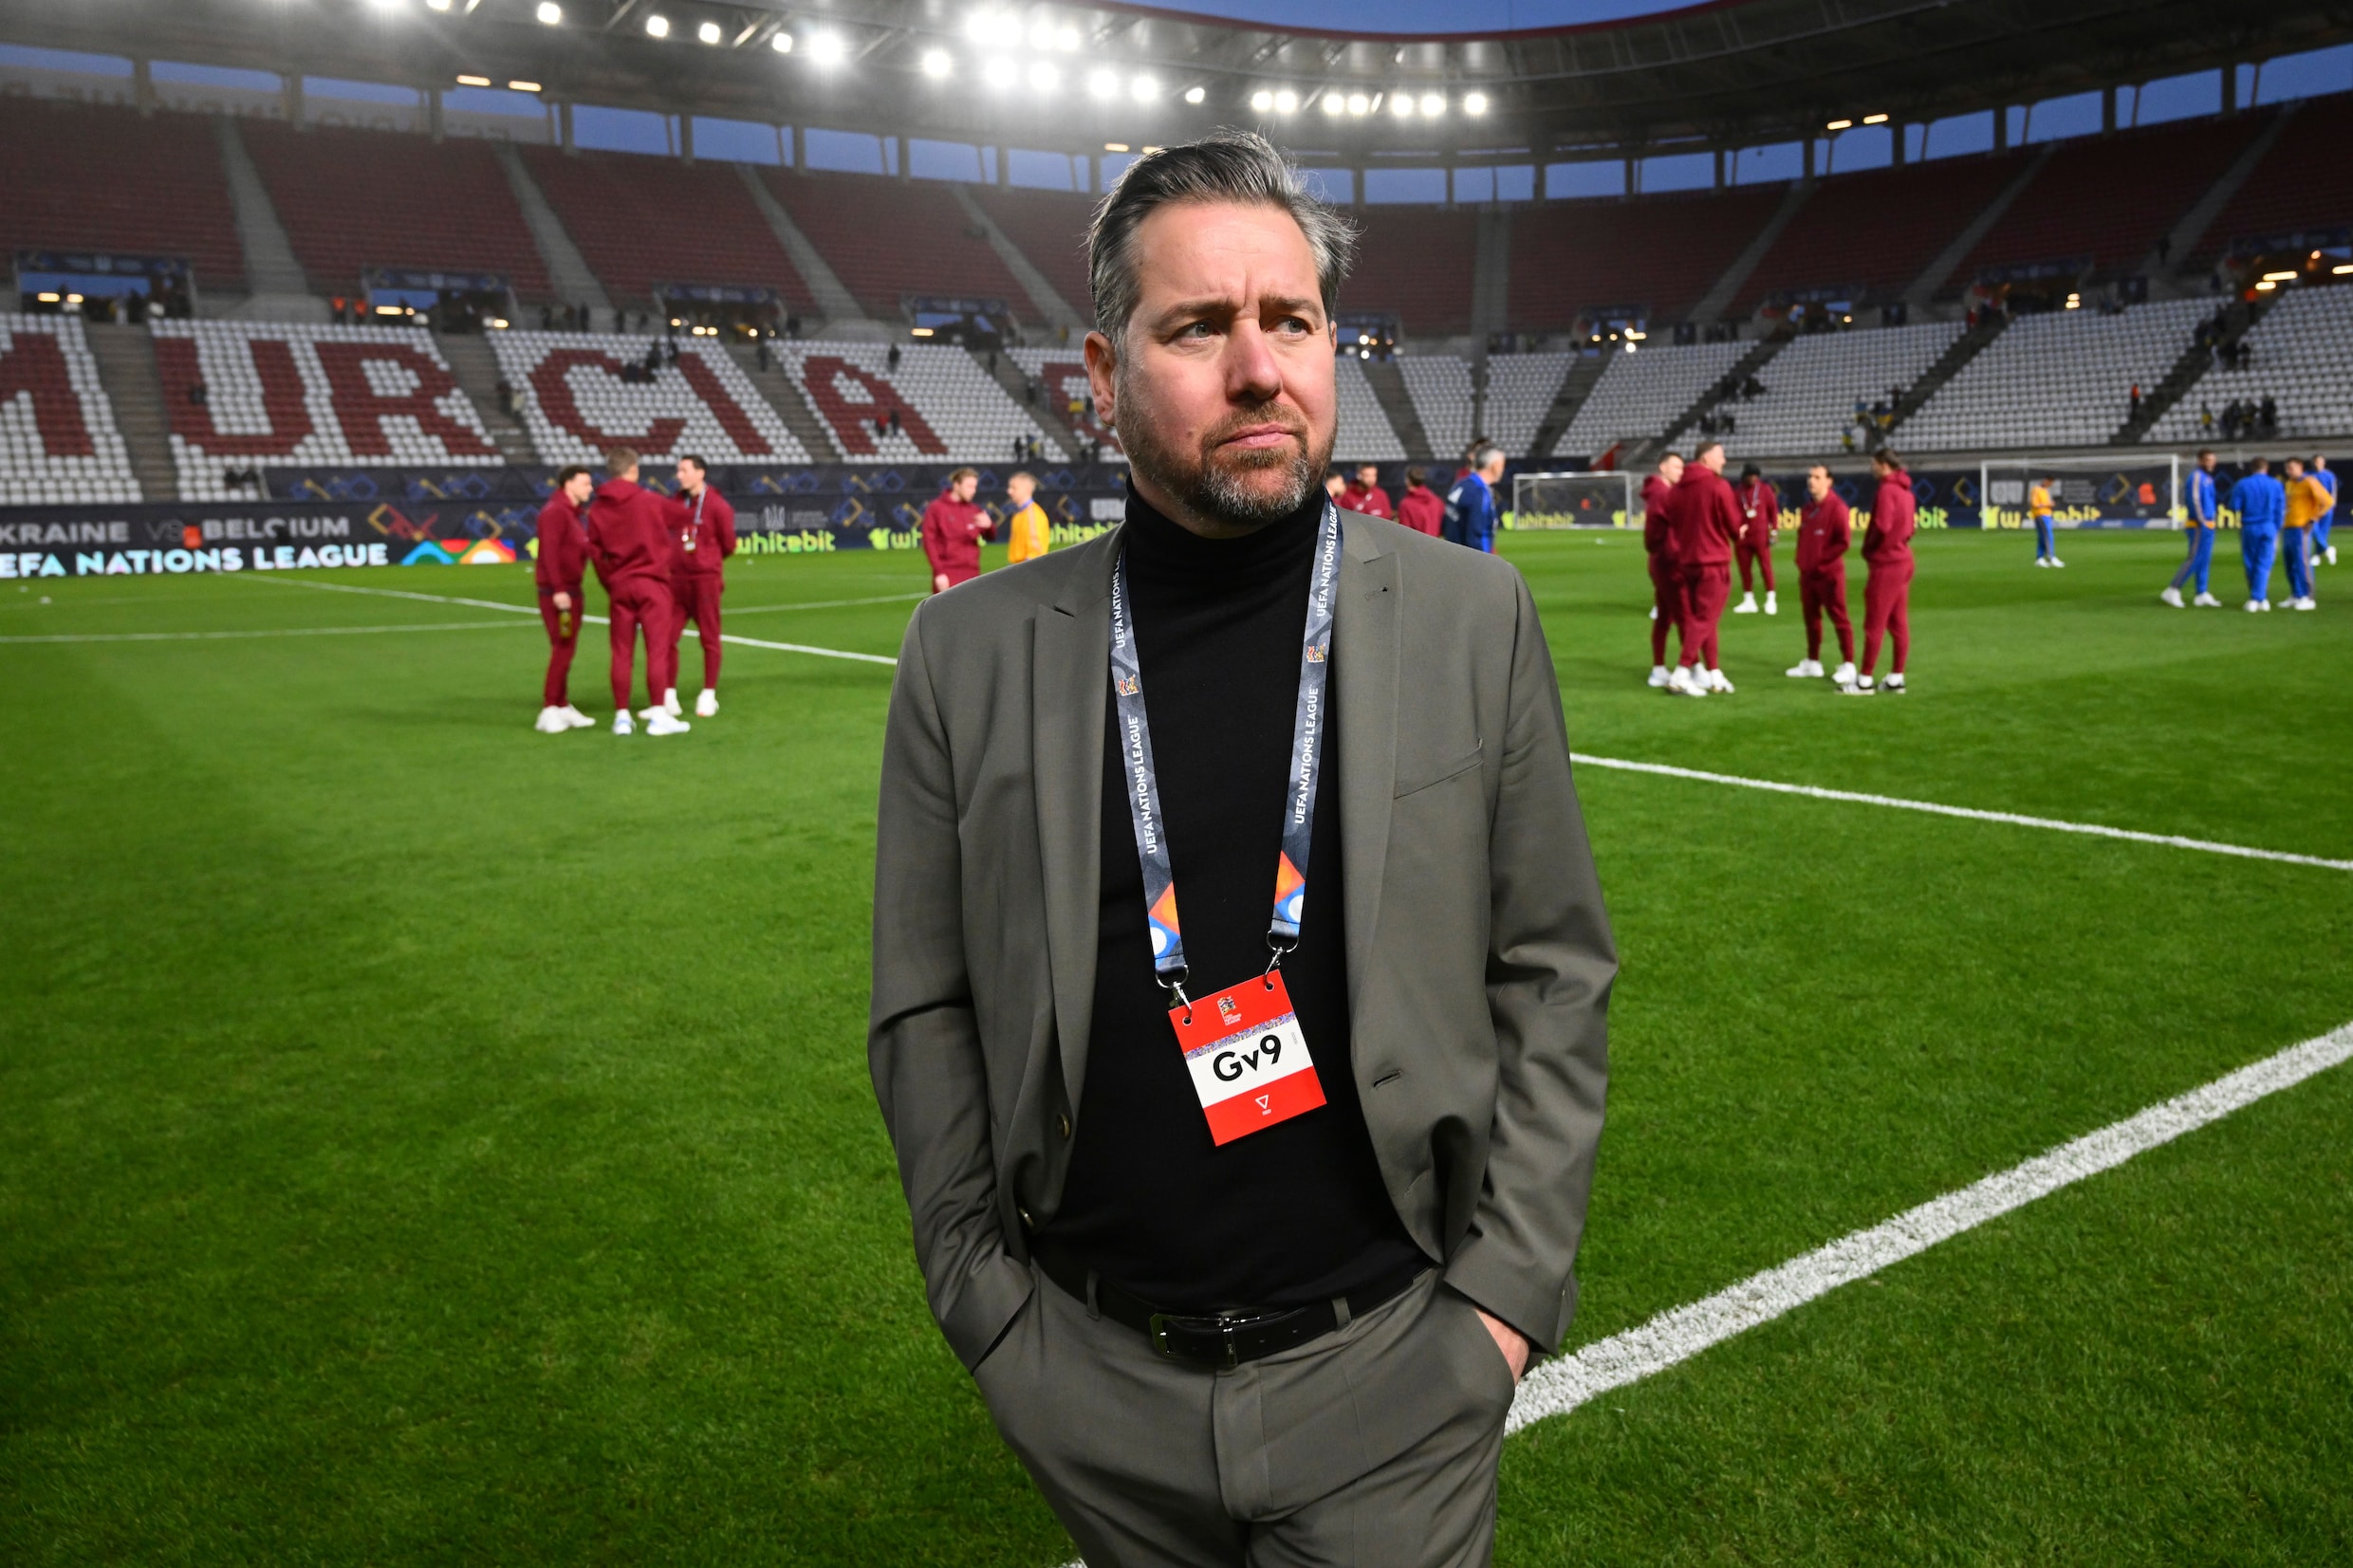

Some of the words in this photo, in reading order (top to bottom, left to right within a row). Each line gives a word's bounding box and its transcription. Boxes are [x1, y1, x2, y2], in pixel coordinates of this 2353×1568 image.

[1327, 504, 1338, 541] LEAGUE
[75, 547, 245, 576] NATIONS
[252, 543, 389, 570] LEAGUE
[1321, 537, 1336, 587] NATIONS
[1112, 572, 1122, 619] NATIONS
[1316, 588, 1329, 618] UEFA
[1114, 618, 1126, 649] UEFA
[1305, 687, 1319, 735] LEAGUE
[1128, 716, 1144, 766] LEAGUE
[1298, 736, 1315, 791] NATIONS
[1134, 766, 1153, 821] NATIONS
[1294, 792, 1308, 825] UEFA
[1144, 821, 1158, 855] UEFA
[1213, 1034, 1282, 1082] Gv9
